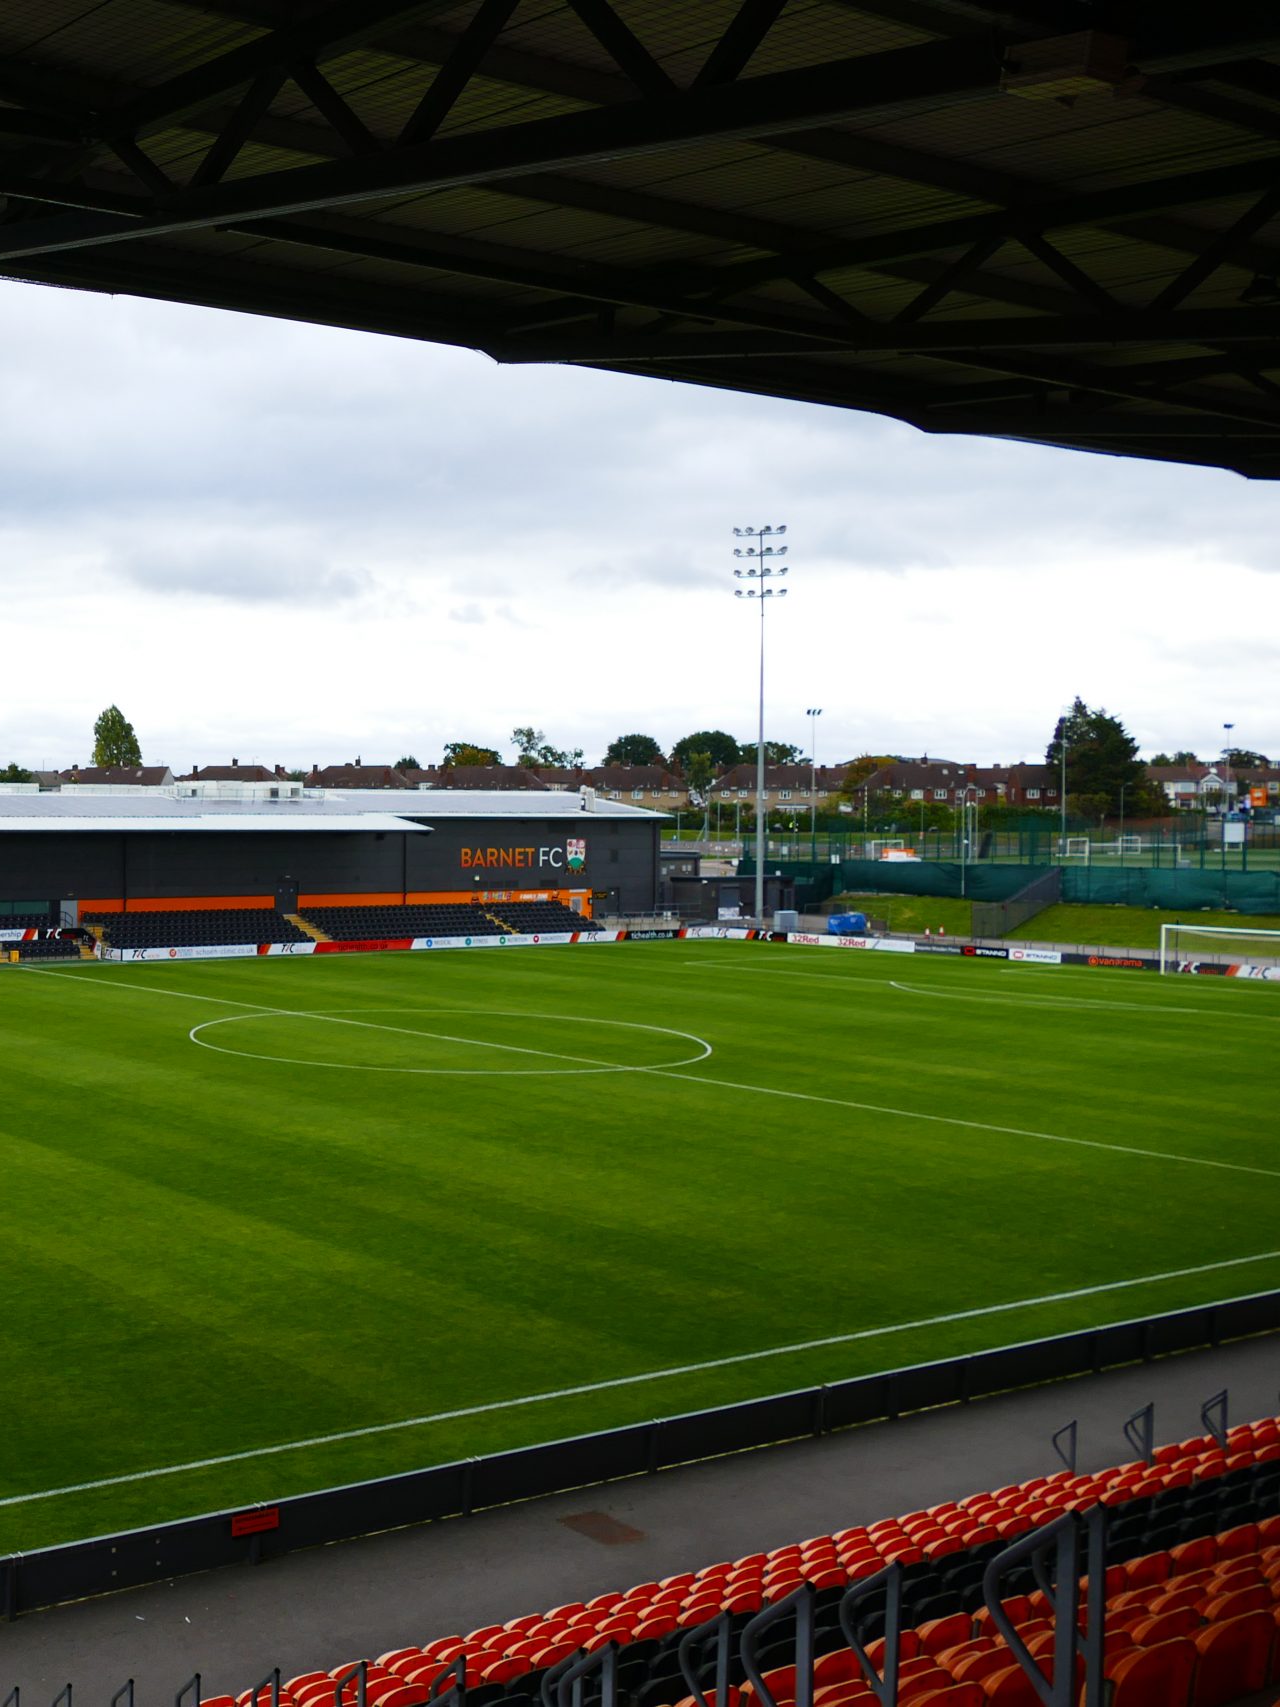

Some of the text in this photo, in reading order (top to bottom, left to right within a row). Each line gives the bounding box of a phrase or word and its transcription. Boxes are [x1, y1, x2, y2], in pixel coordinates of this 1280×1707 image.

[461, 847, 563, 868] BARNET FC
[792, 935, 819, 943] 32Red
[838, 938, 866, 947] 32Red
[1098, 958, 1143, 967] vanarama
